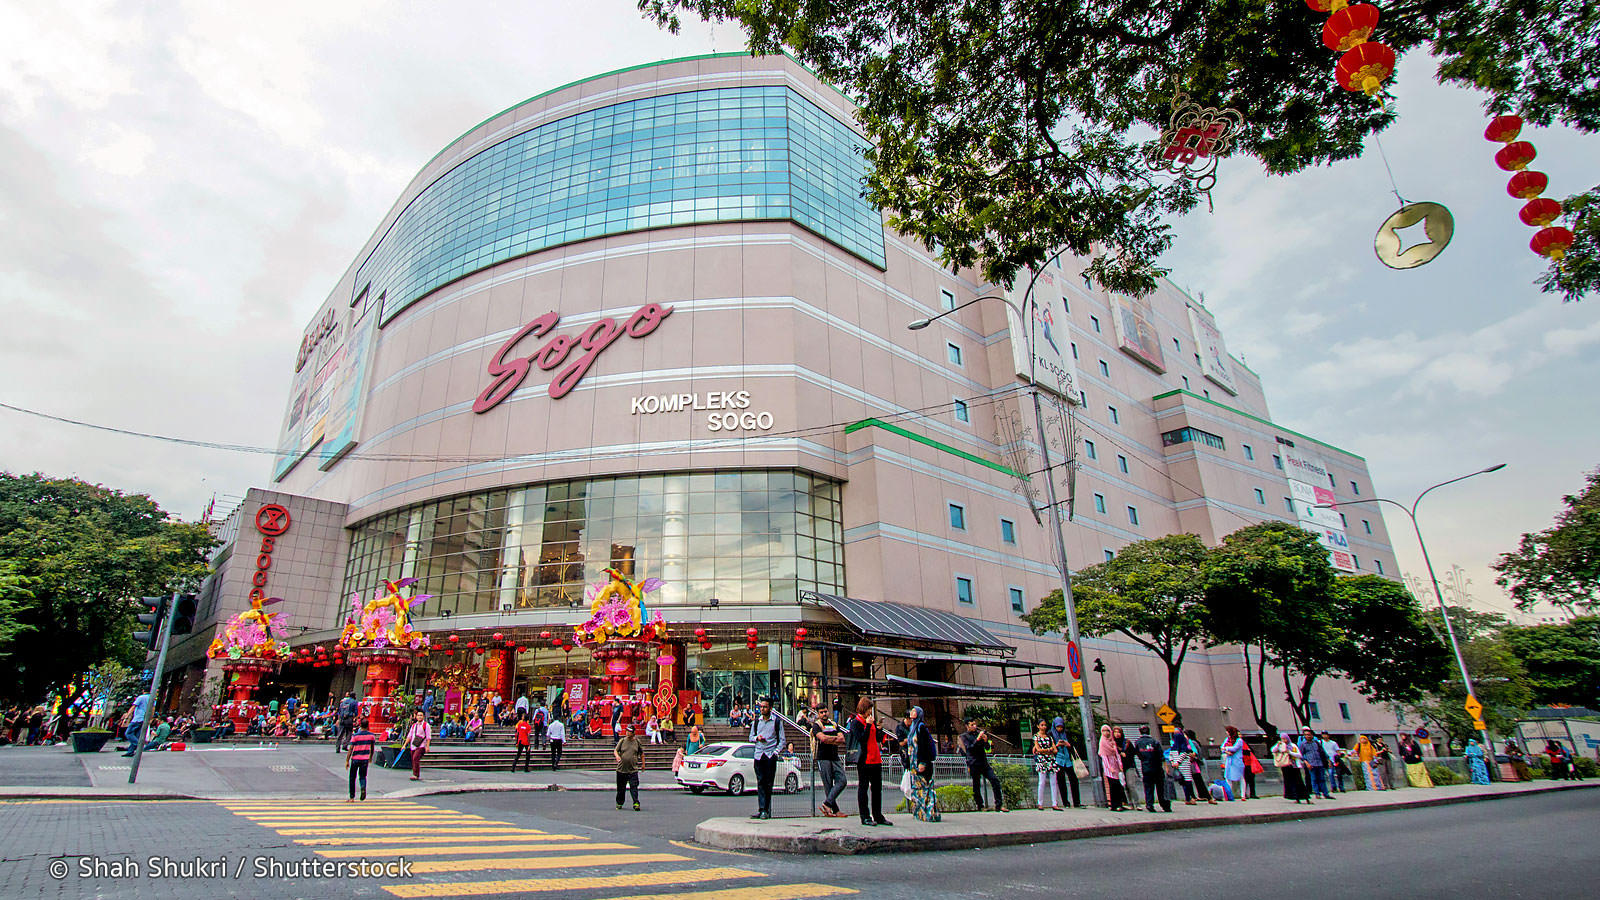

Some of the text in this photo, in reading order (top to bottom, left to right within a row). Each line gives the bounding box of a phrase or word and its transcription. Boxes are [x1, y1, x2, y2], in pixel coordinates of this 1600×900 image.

[472, 302, 674, 414] Sogo
[1038, 356, 1073, 384] KL SOGO
[631, 390, 751, 415] KOMPLEKS
[707, 411, 774, 431] SOGO
[1326, 530, 1348, 547] FILA
